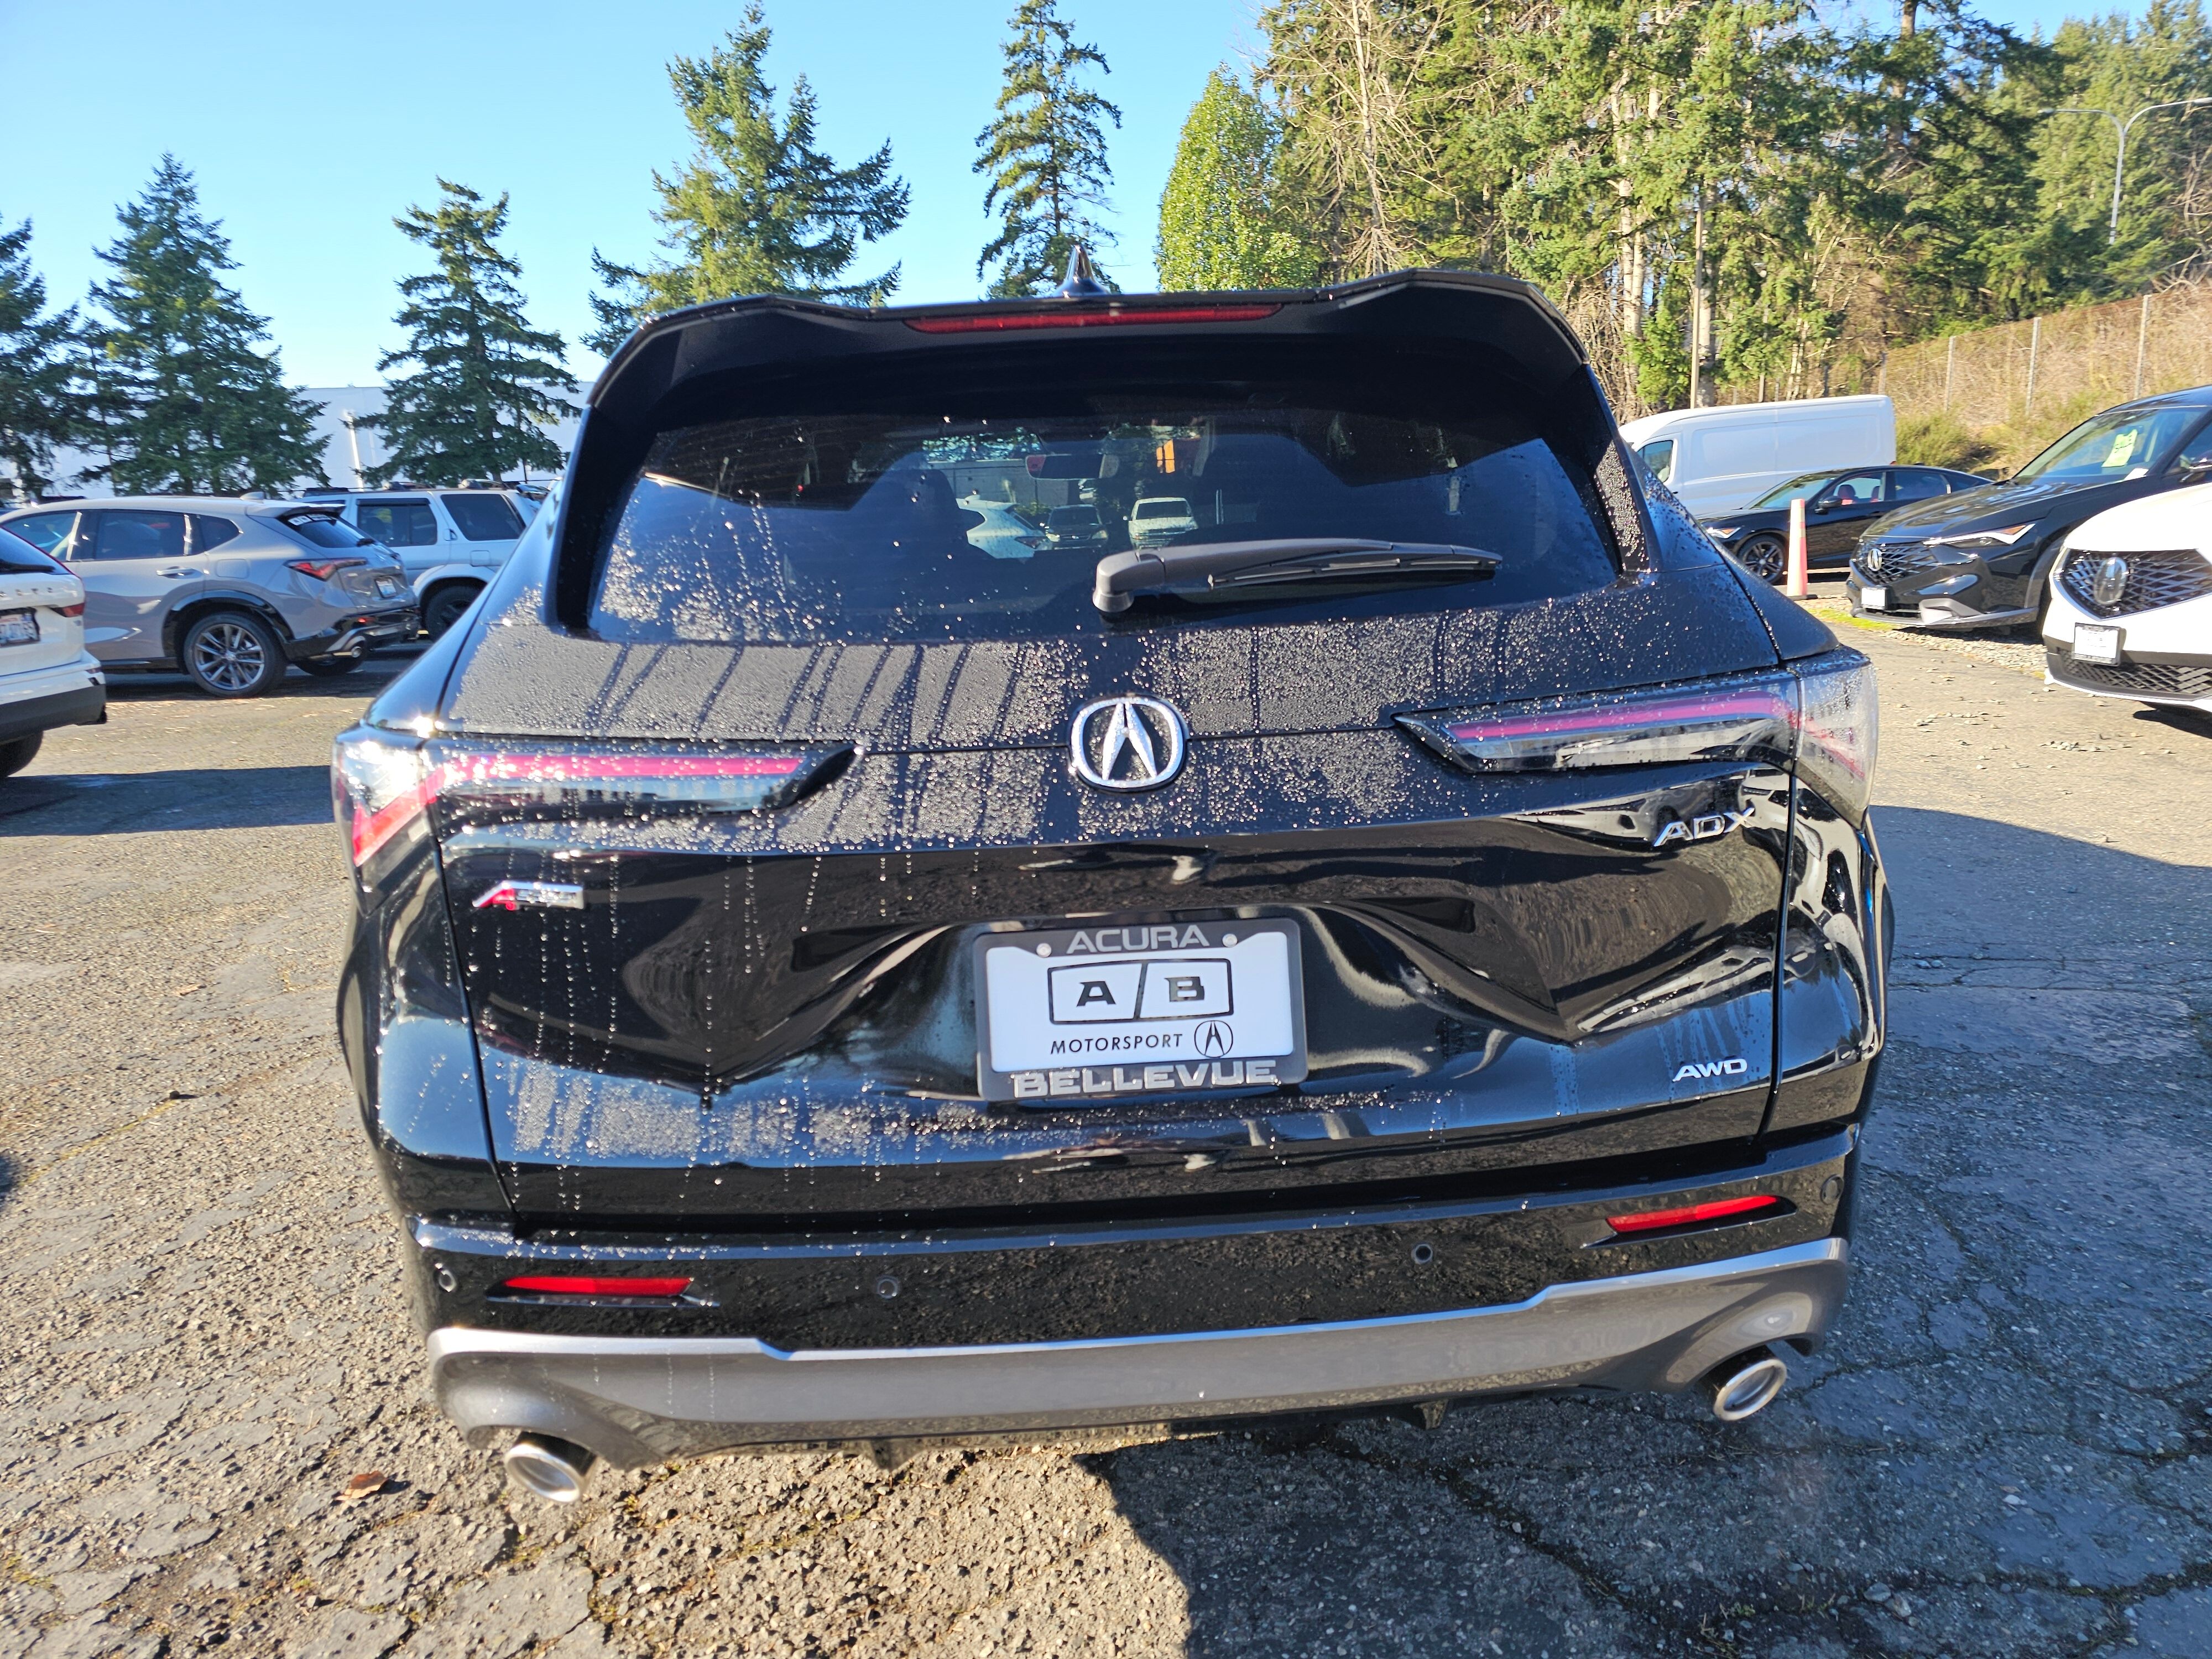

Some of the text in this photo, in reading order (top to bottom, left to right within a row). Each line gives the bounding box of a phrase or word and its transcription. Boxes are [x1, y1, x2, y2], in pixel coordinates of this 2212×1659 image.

[1653, 807, 1755, 847] ADX
[1066, 925, 1210, 954] ACURA
[1076, 976, 1205, 1007] A B
[1050, 1033, 1183, 1055] MOTORSPORT
[1014, 1060, 1277, 1098] BELLEVUE
[1672, 1058, 1747, 1082] AWD
